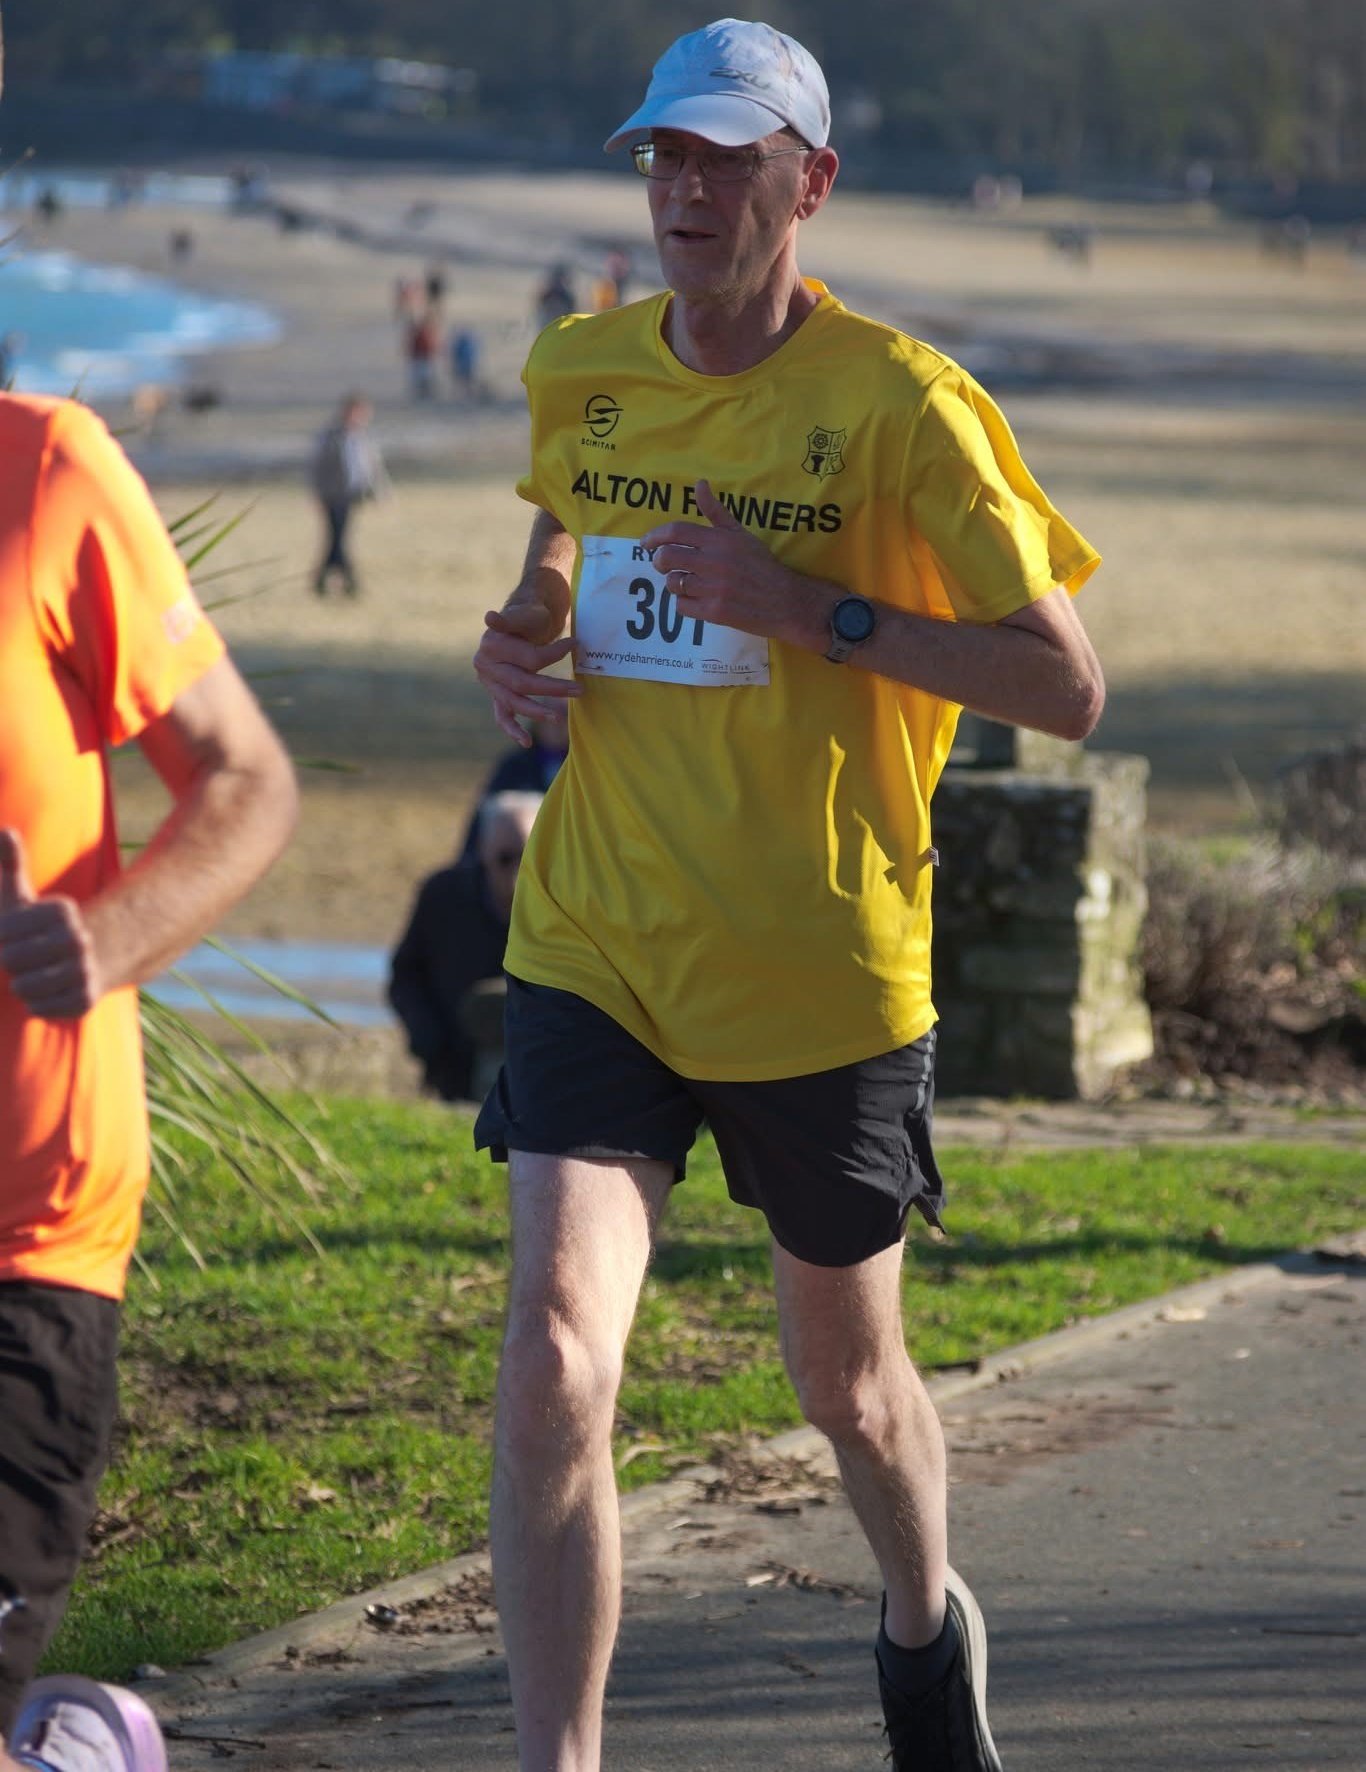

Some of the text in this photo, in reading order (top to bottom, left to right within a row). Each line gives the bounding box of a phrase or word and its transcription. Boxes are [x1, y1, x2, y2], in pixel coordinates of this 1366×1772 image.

[581, 437, 616, 451] SCIMITAR
[571, 469, 842, 534] ALTON RNNERS
[585, 650, 694, 669] www.rydeharriers.co.uk
